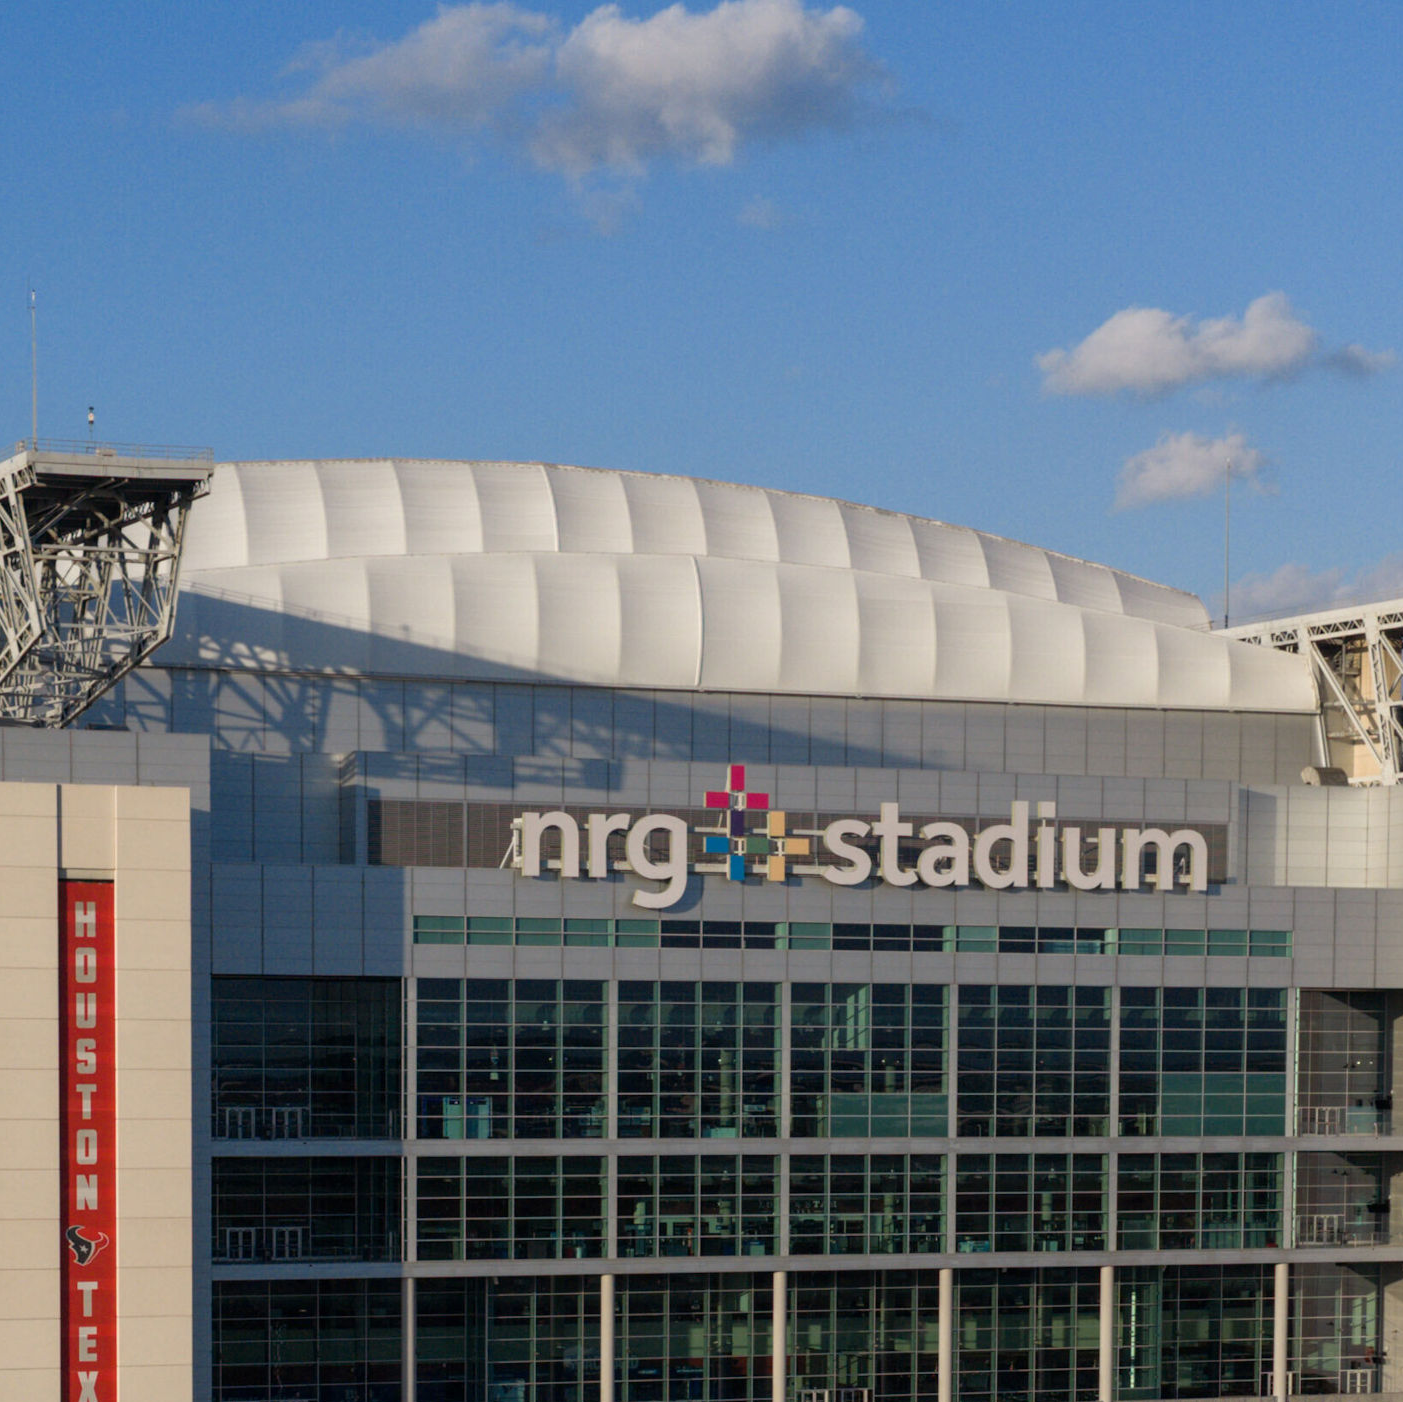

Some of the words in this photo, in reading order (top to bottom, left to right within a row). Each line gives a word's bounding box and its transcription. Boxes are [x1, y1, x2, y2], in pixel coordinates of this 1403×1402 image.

[519, 809, 688, 909] nrg
[822, 800, 1209, 892] stadium
[74, 900, 97, 1211] HOUSTON
